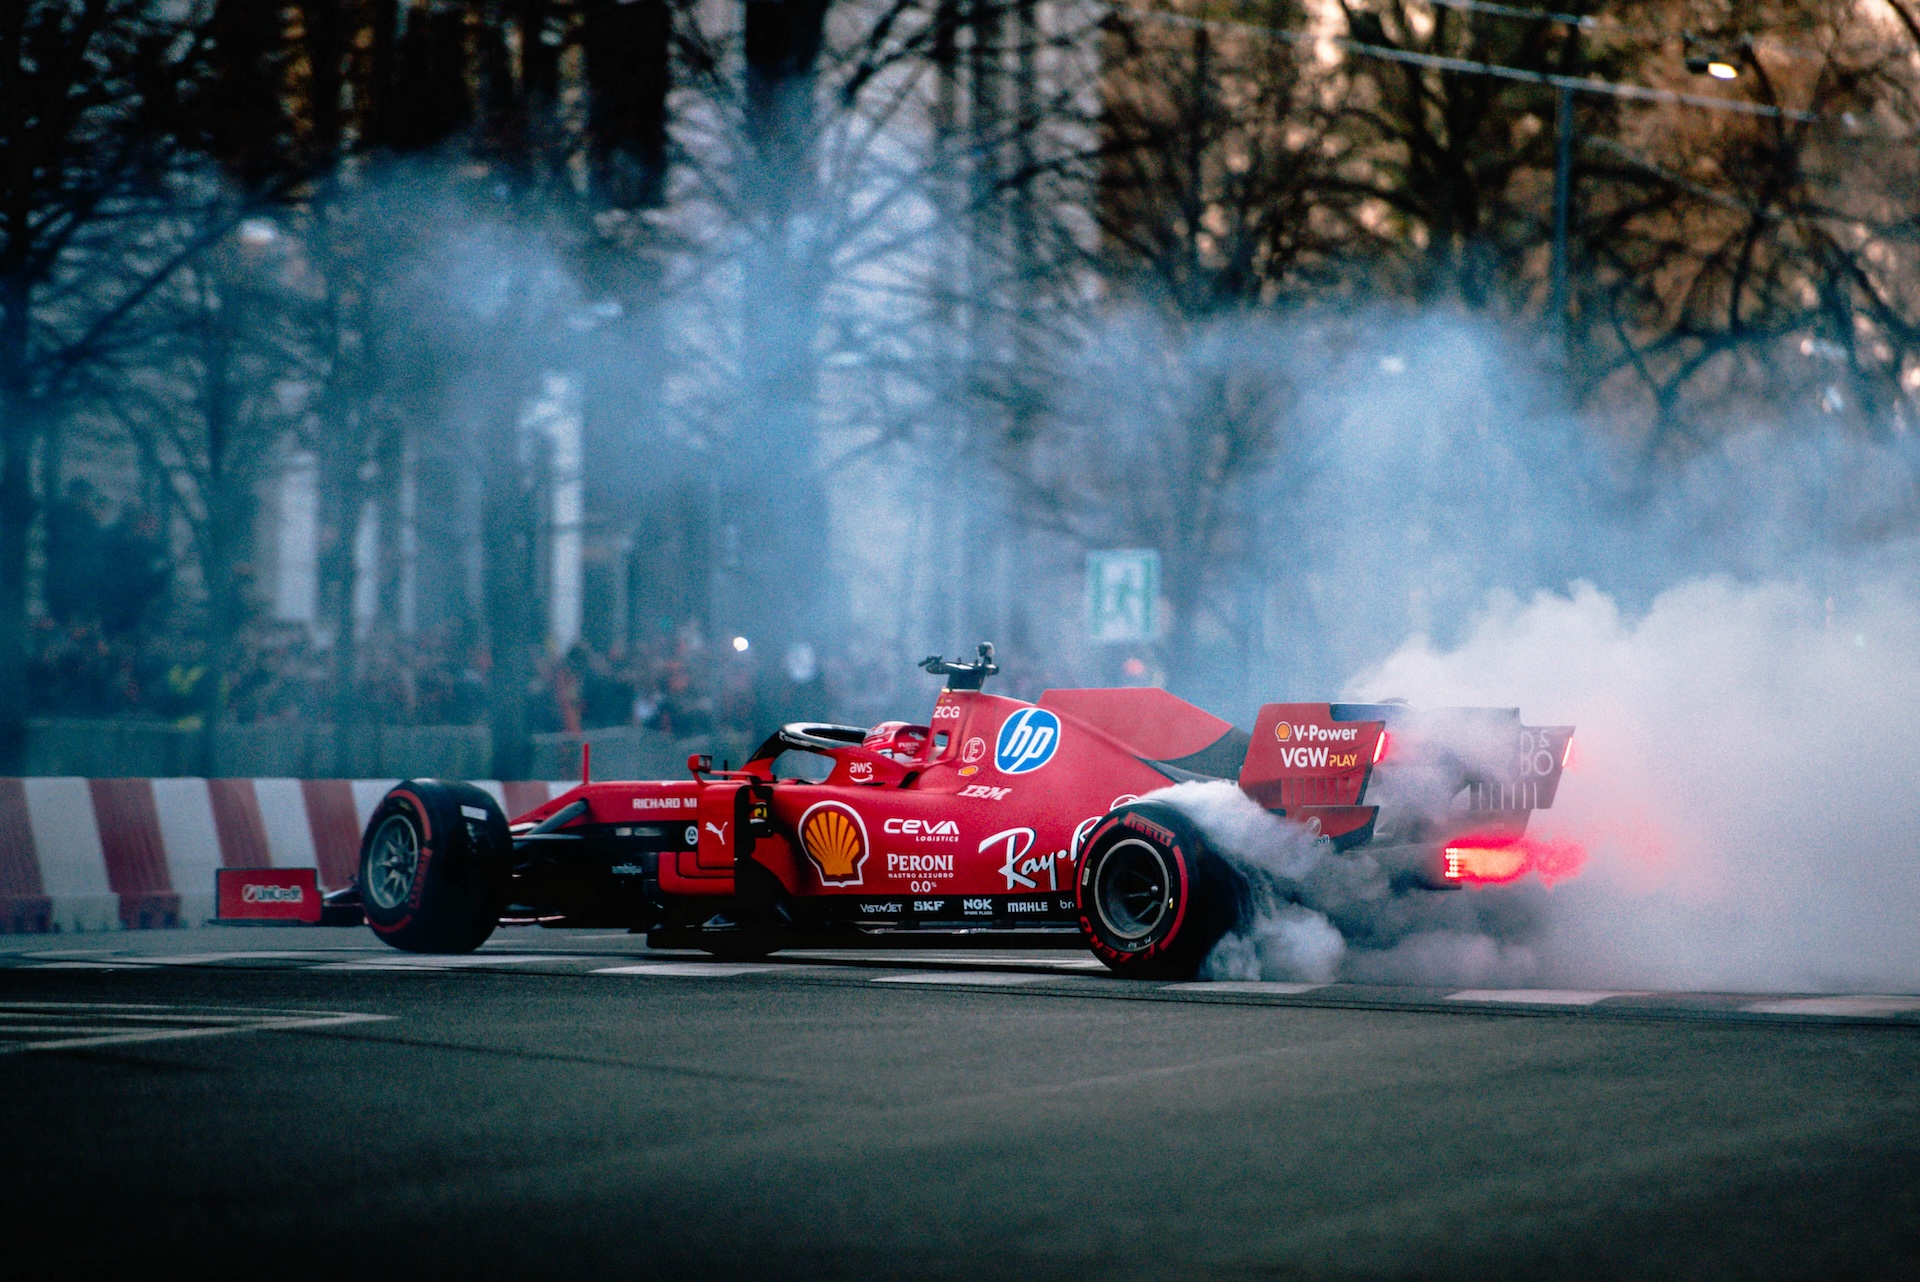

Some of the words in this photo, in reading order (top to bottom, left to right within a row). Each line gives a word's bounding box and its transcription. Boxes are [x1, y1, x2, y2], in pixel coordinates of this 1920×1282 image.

[933, 705, 960, 718] ZCG
[1293, 724, 1358, 741] V-Power
[1000, 709, 1055, 773] hp
[1280, 747, 1329, 768] VGW
[1329, 754, 1357, 767] PLAY
[849, 761, 873, 774] aws
[957, 784, 1012, 800] IBM
[632, 798, 681, 809] RICHARD
[1124, 811, 1176, 848] PIRELLI
[887, 853, 954, 871] PERONI
[914, 900, 945, 912] SKF
[963, 899, 992, 910] NGK
[1007, 901, 1048, 912] MAHLE
